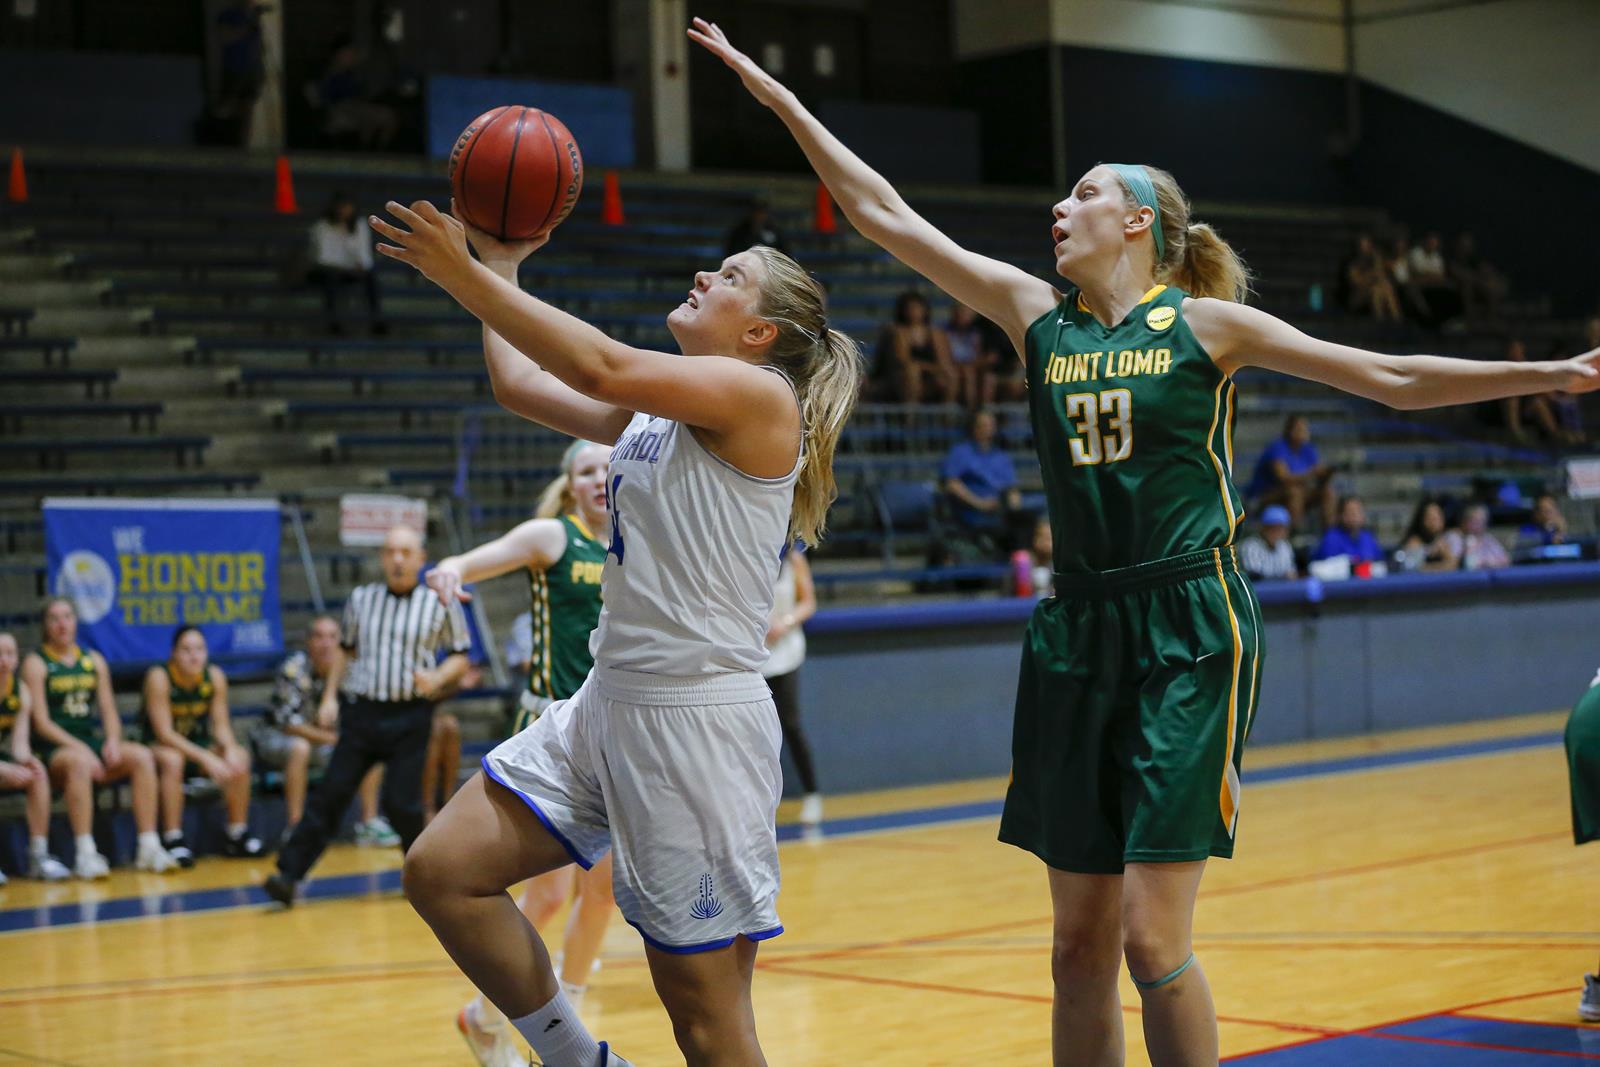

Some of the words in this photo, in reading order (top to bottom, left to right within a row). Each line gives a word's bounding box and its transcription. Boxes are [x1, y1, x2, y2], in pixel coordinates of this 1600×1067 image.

[1105, 348, 1173, 378] LOMA
[1065, 388, 1133, 467] 33
[119, 552, 266, 592] HONOR
[119, 596, 178, 625] THE
